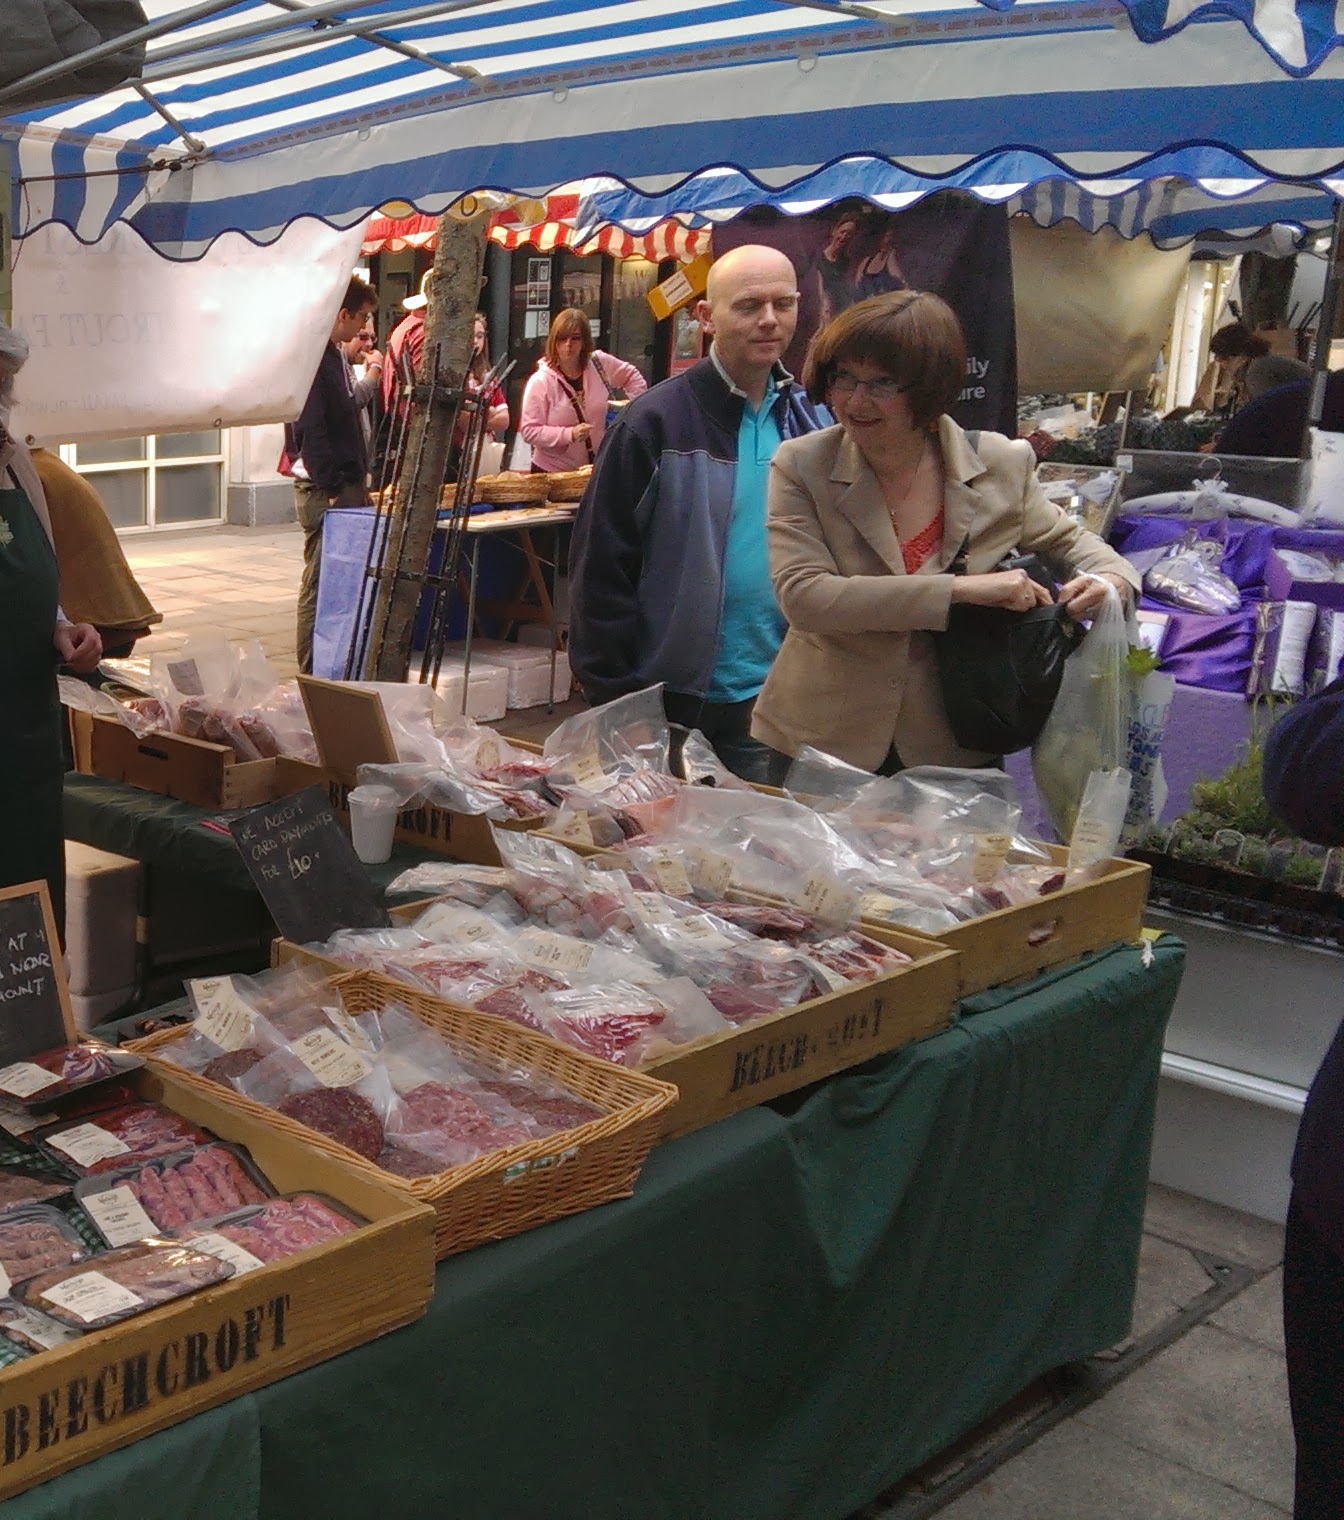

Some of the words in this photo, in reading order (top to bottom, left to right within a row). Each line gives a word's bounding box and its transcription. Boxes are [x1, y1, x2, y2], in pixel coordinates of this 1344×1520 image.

[965, 356, 990, 379] ily
[251, 838, 278, 863] CARD
[8, 931, 28, 951] AT
[1, 1294, 291, 1467] BEECHCROFT
